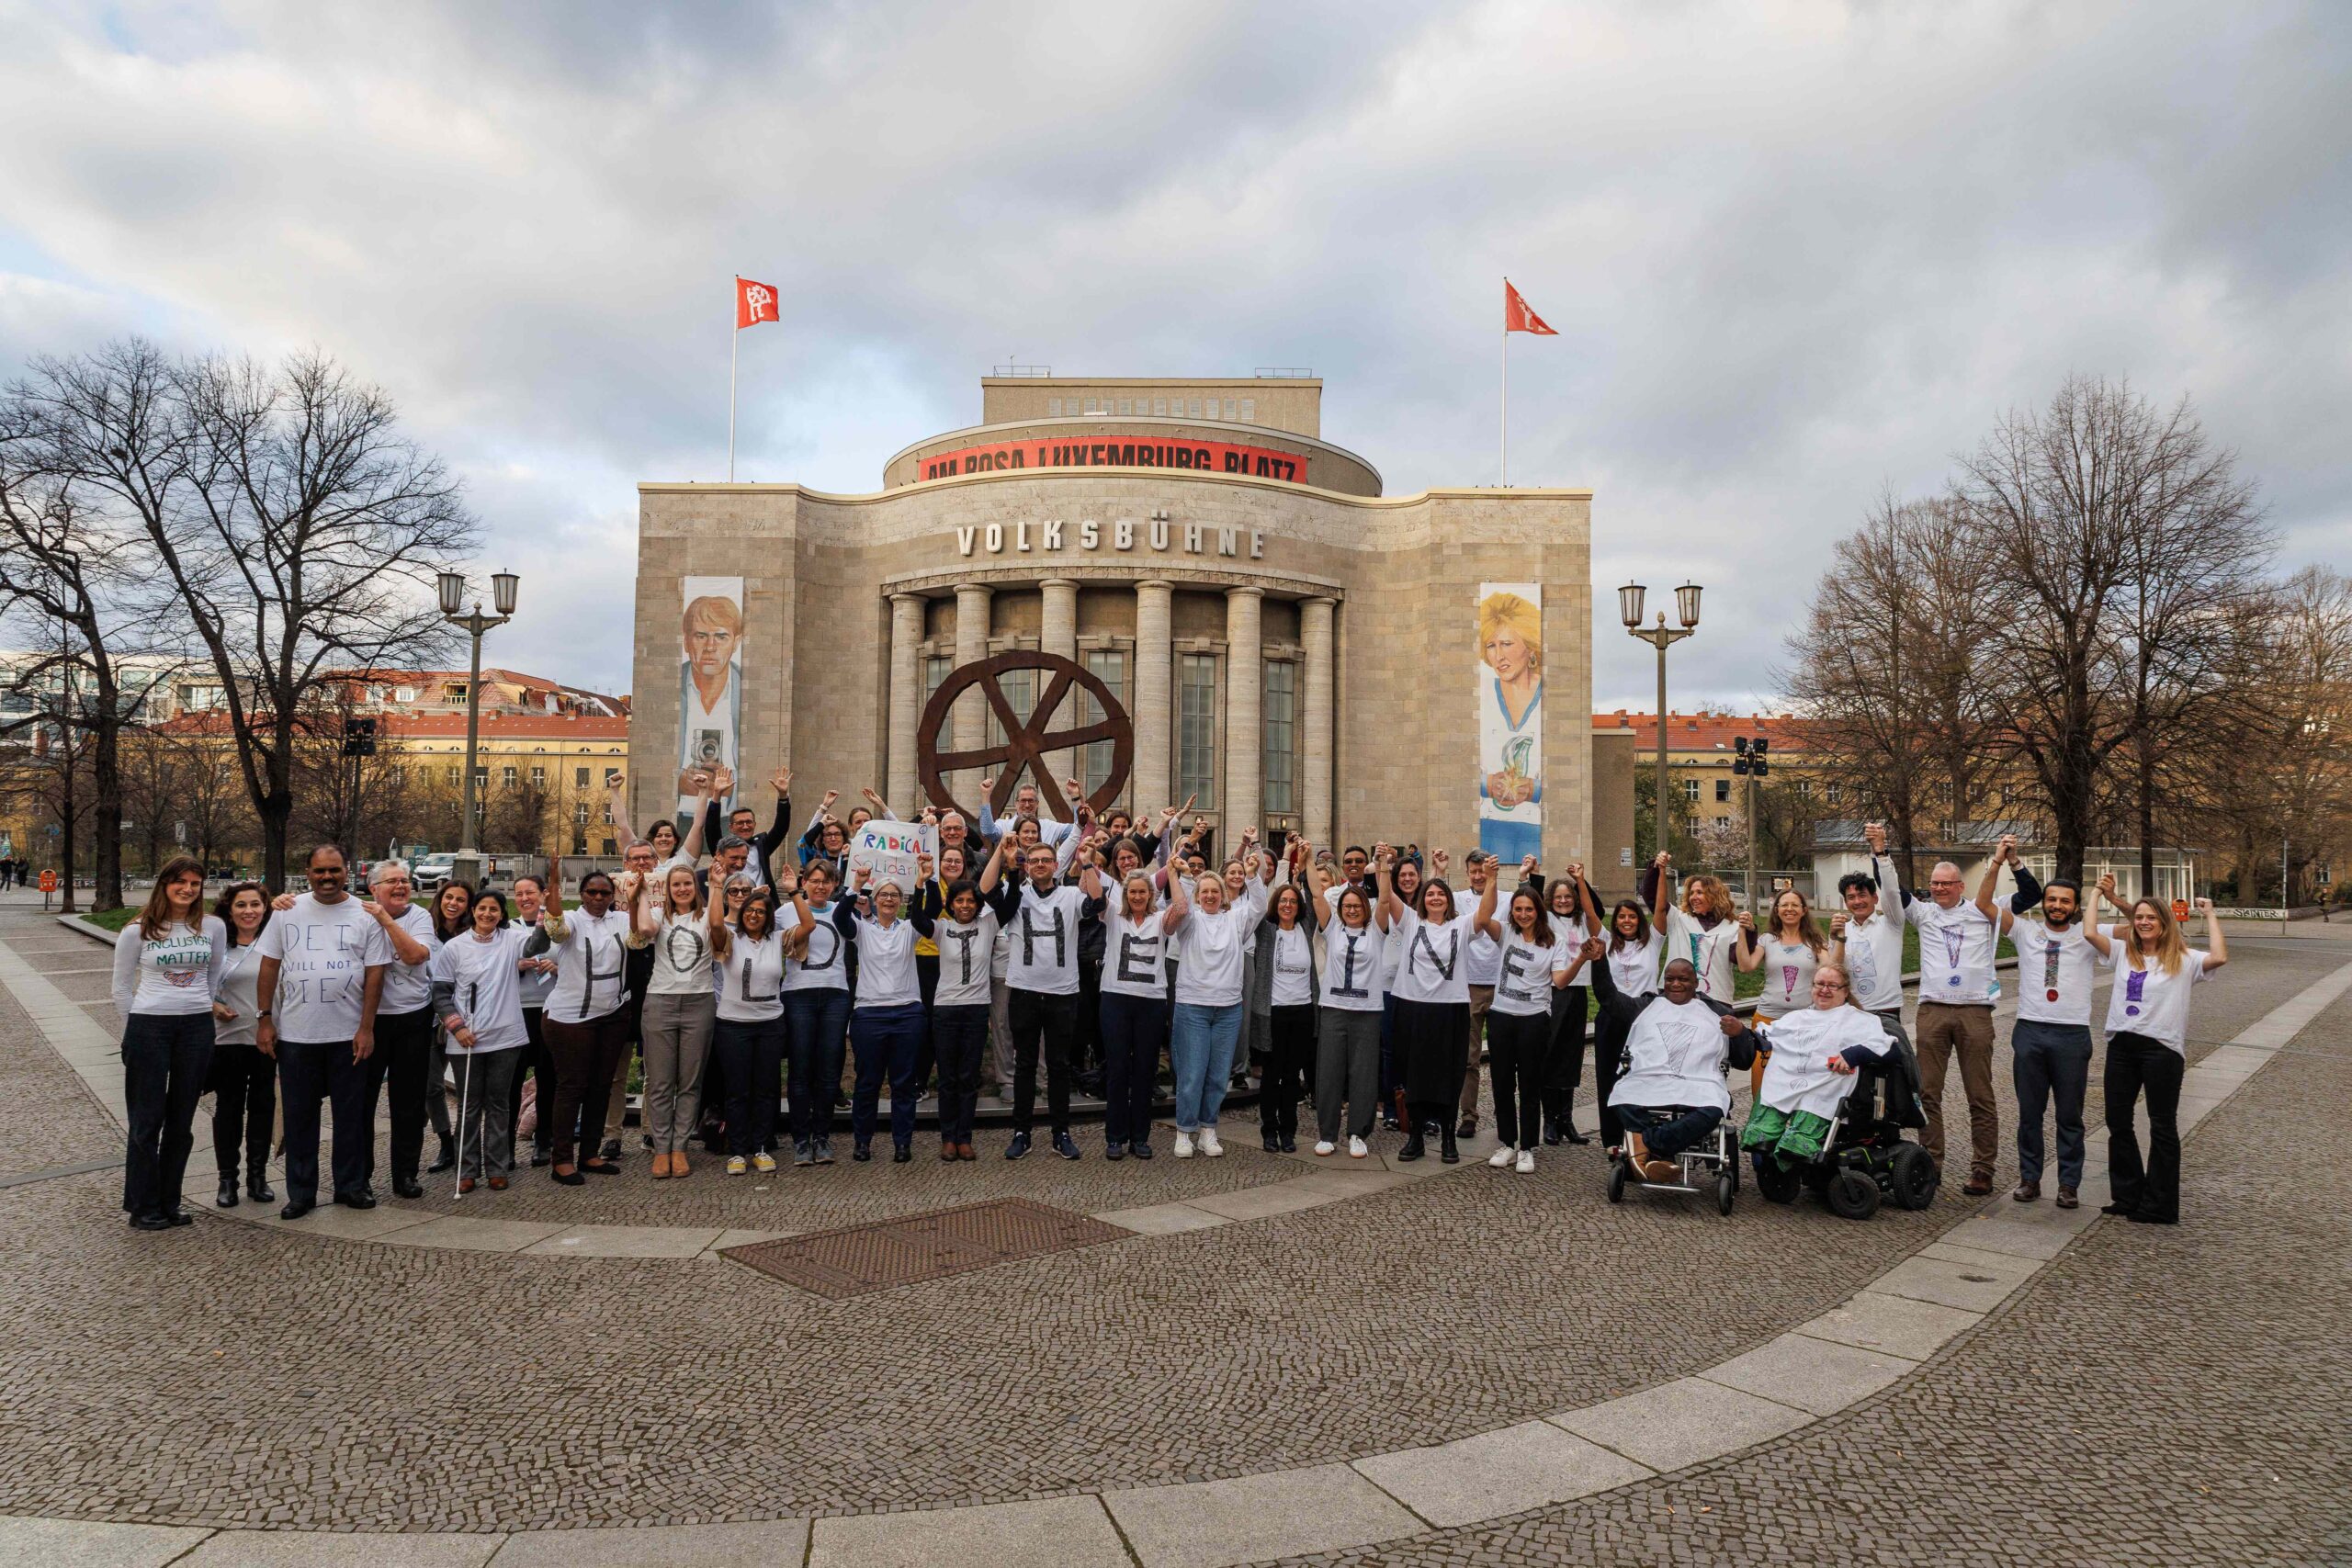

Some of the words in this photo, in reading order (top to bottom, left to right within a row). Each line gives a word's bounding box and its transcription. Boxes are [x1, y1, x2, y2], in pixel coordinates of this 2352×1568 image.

[956, 509, 1263, 558] VOLKSBÜHNE
[147, 935, 211, 951] INCLUSION
[285, 923, 352, 952] DEI
[666, 924, 704, 973] O
[946, 928, 979, 985] T
[1022, 907, 1066, 968] H
[1117, 932, 1159, 984] E
[1276, 936, 1306, 974] L
[1329, 927, 1369, 998] I
[1408, 925, 1458, 981] N
[281, 961, 316, 973] WILL
[326, 960, 351, 970] NOT
[579, 932, 626, 1019] H
[741, 957, 777, 1002] L
[1498, 944, 1535, 1002] E
